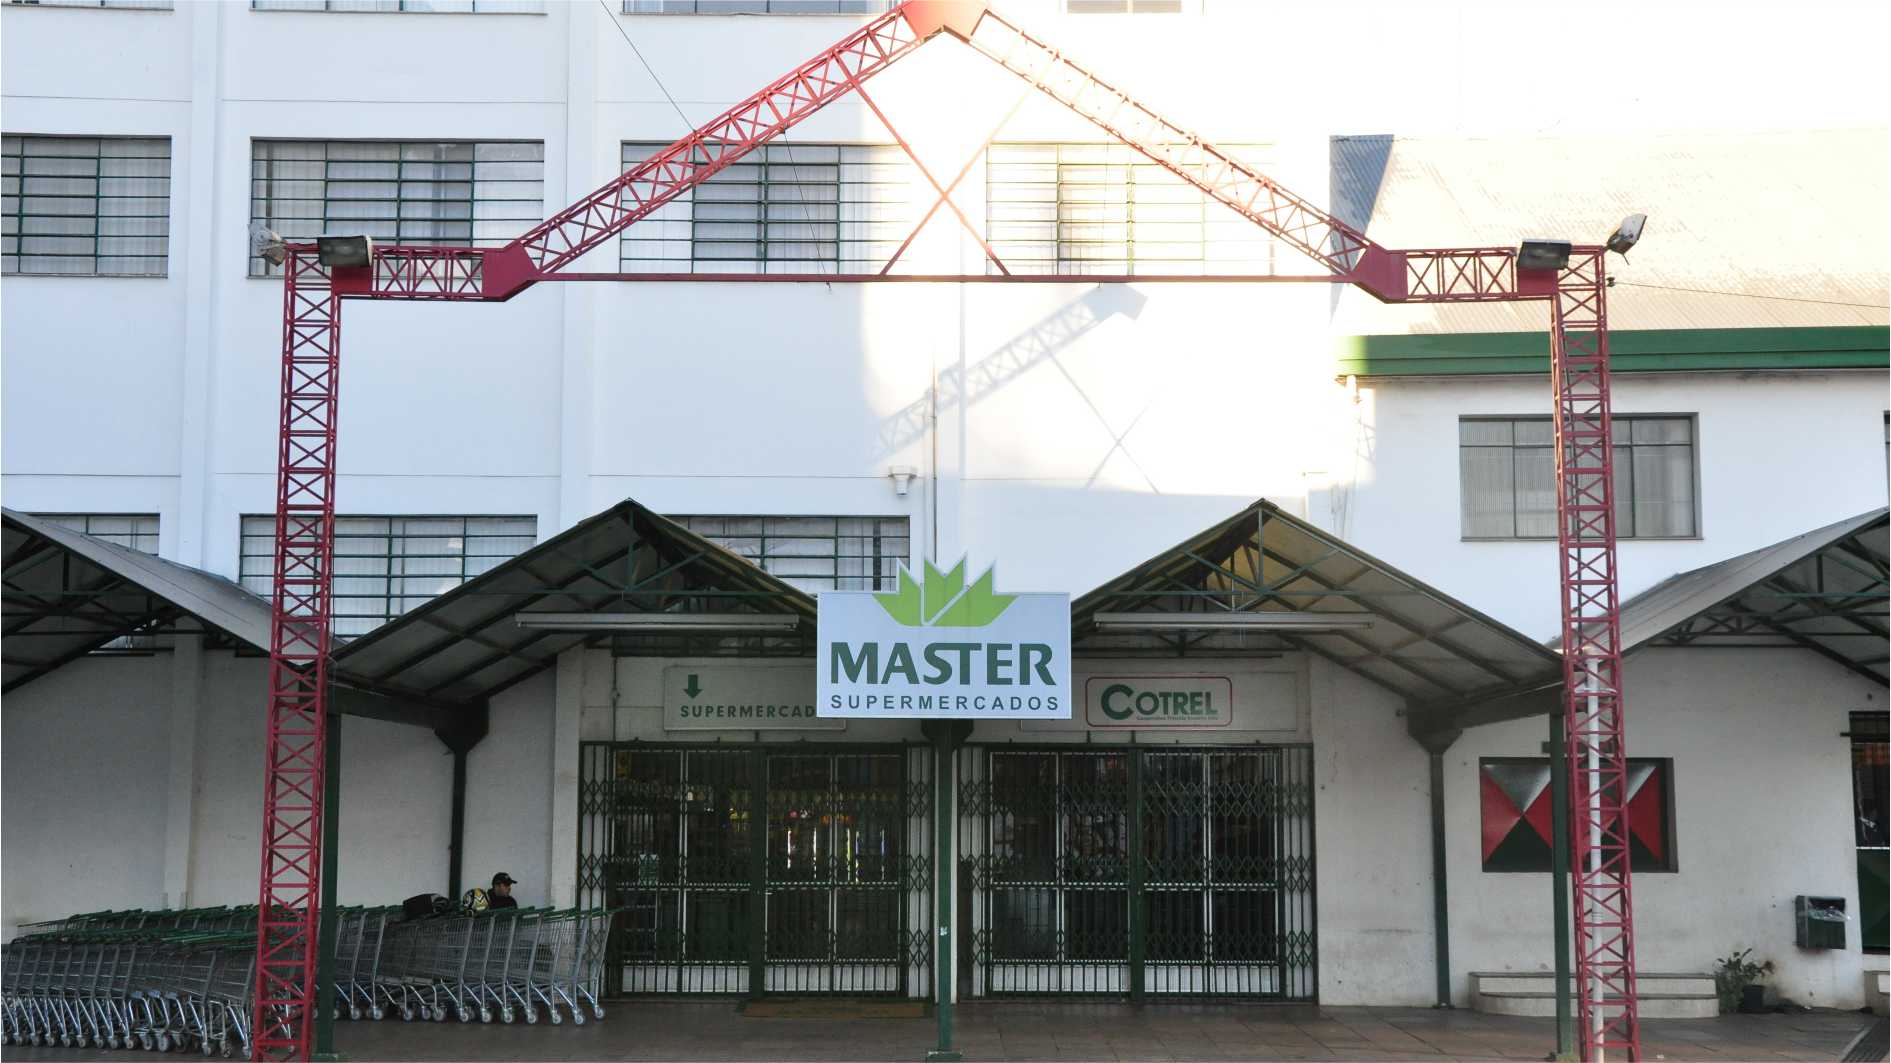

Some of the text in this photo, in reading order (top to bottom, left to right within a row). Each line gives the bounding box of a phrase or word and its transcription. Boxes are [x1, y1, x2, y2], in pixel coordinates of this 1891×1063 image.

[831, 642, 1057, 686] MASTER
[680, 705, 816, 718] SUPERMERCAD
[831, 695, 1058, 711] SUPERMERCADOS
[1101, 684, 1218, 720] COTREL
